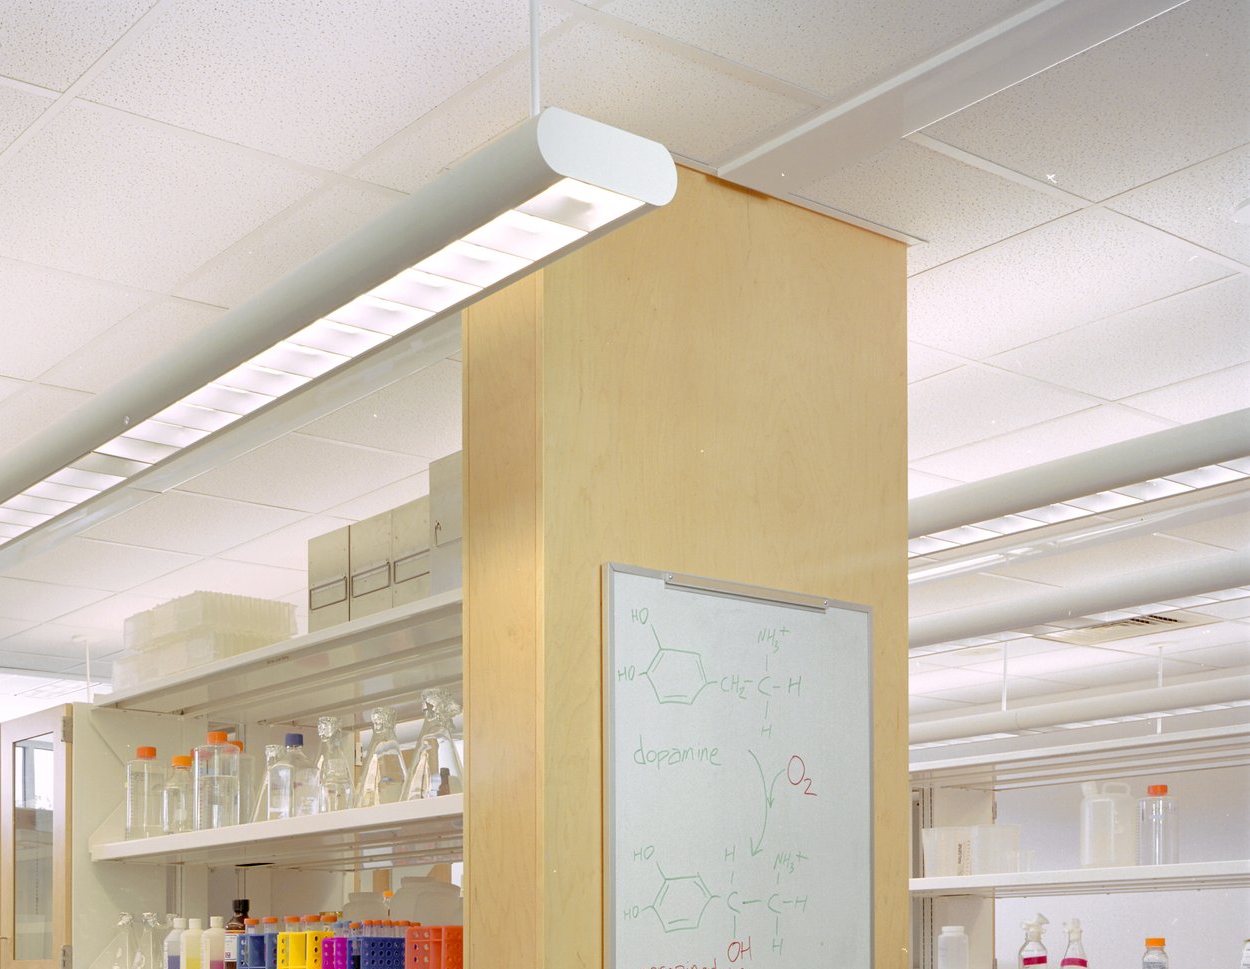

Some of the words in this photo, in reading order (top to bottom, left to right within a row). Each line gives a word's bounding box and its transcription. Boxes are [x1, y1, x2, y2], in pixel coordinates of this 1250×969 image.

[632, 608, 648, 624] HO
[618, 666, 635, 681] HO
[761, 725, 772, 736] H
[634, 734, 722, 770] dopamine
[634, 845, 654, 861] HO
[725, 845, 735, 862] H
[624, 906, 639, 920] HO
[727, 936, 752, 962] OH
[772, 938, 783, 956] H
